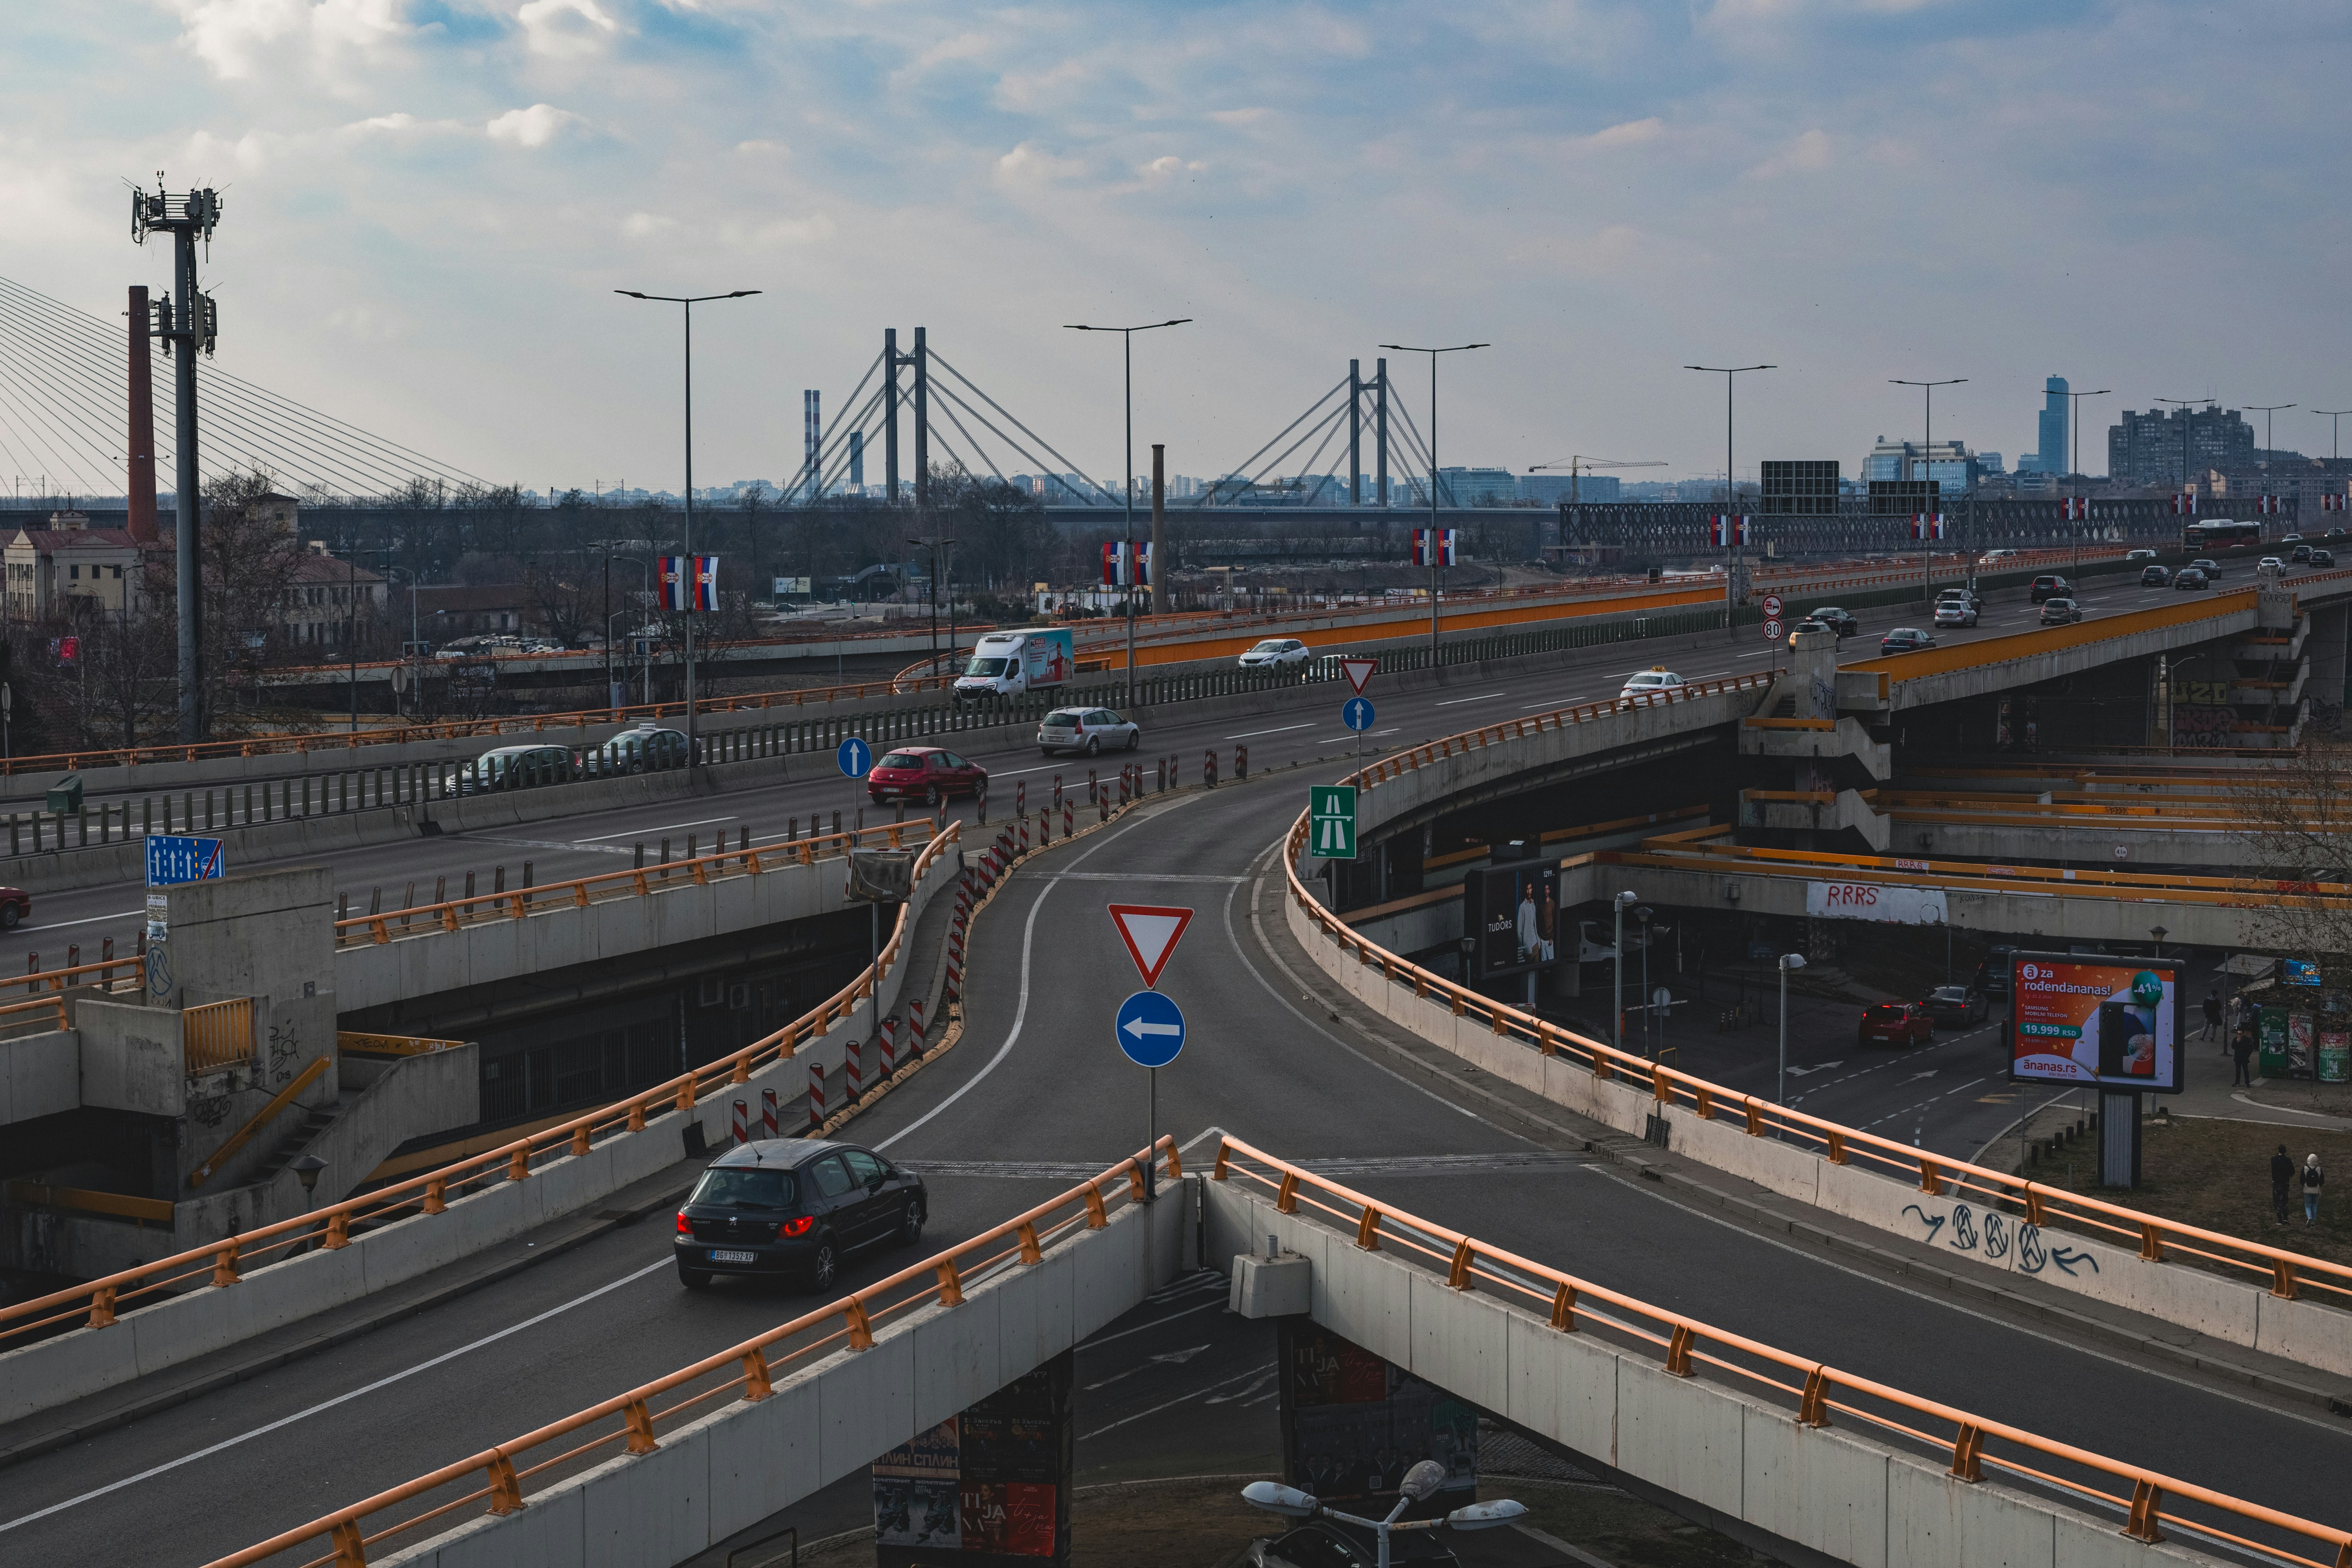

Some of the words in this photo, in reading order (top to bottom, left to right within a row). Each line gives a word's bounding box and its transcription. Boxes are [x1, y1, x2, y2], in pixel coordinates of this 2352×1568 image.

[1766, 624, 1779, 636] 80
[1828, 885, 1879, 907] RRRS
[1489, 920, 1512, 932] TUDORS
[2041, 970, 2053, 978] za
[2134, 983, 2161, 994] -41%
[2025, 1025, 2059, 1035] 19.999
[2024, 1059, 2077, 1073] ānanas.rs
